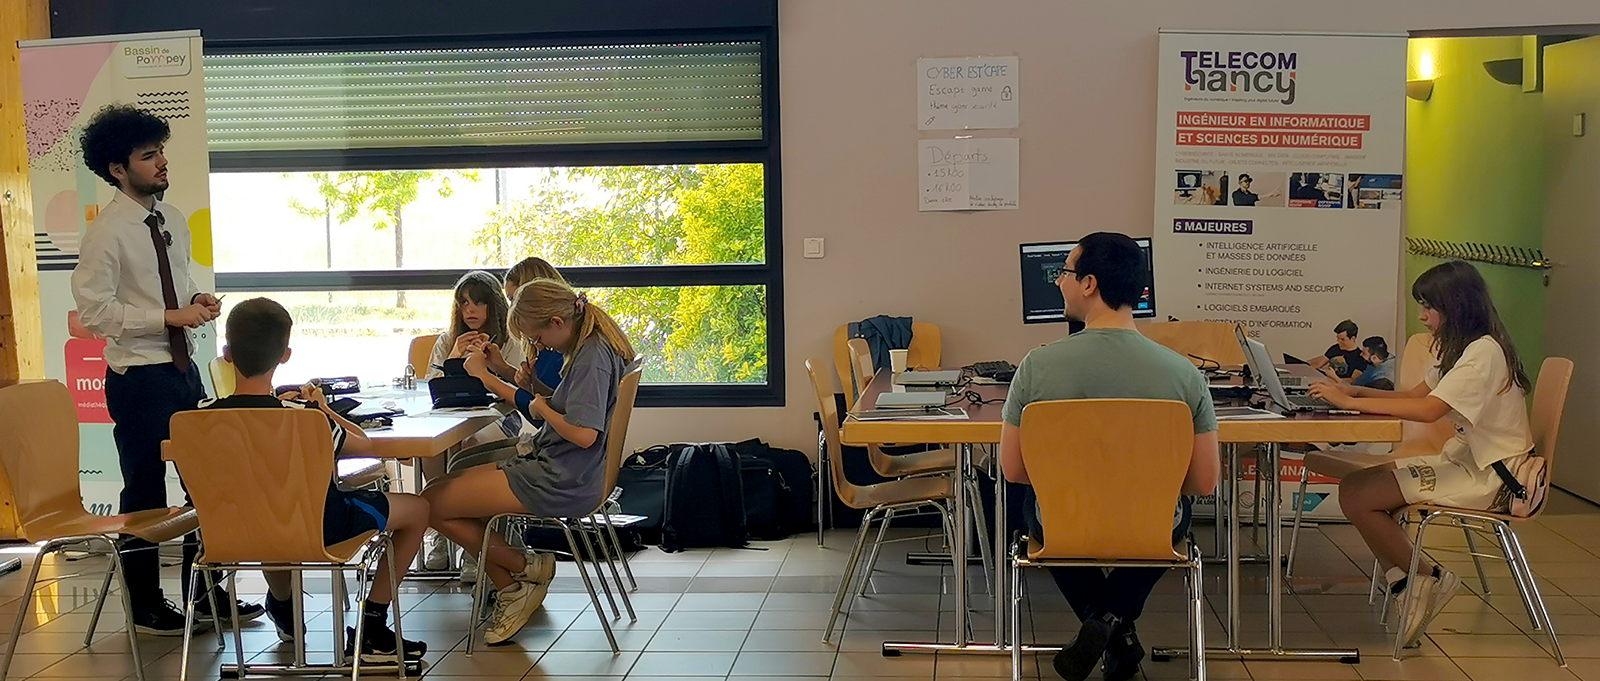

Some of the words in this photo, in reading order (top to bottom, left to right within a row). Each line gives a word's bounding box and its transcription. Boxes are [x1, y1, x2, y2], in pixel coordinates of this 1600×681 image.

[124, 46, 160, 56] Bassin
[136, 55, 187, 66] Pompey
[926, 66, 964, 79] CYBER
[1180, 51, 1297, 84] TELECOM
[929, 84, 965, 98] Escape
[971, 86, 993, 97] game
[1185, 69, 1297, 105] nancy
[1179, 113, 1247, 126] INGÉNIEUR
[1250, 116, 1266, 126] EN
[1270, 116, 1365, 128] INFORMATIQUE
[1178, 133, 1193, 143] ET
[1196, 133, 1258, 144] SCIENCES
[1261, 134, 1279, 145] DU
[1282, 133, 1359, 147] NUMÉRIQUE
[926, 146, 989, 170] Départs
[933, 168, 965, 178] 15h00
[1175, 221, 1182, 231] 5
[1184, 222, 1247, 233] MAJEURES
[1206, 242, 1264, 250] INTELLIGENCE
[1266, 243, 1318, 251] ARTIFICIELLE
[1218, 253, 1252, 261] MASSES
[1267, 252, 1306, 262] DONNÉES
[1205, 267, 1251, 276] INGÉNIERIE
[1266, 269, 1304, 277] LOGICIEL
[1205, 283, 1243, 291] INTERNET
[1245, 284, 1284, 292] SYSTEMS
[1285, 284, 1303, 292] AND
[1304, 285, 1344, 293] SECURITY
[1204, 304, 1248, 312] LOGICIELS
[1249, 304, 1301, 313] EMBARQUÉS
[1249, 320, 1313, 329] D'INFORMATION
